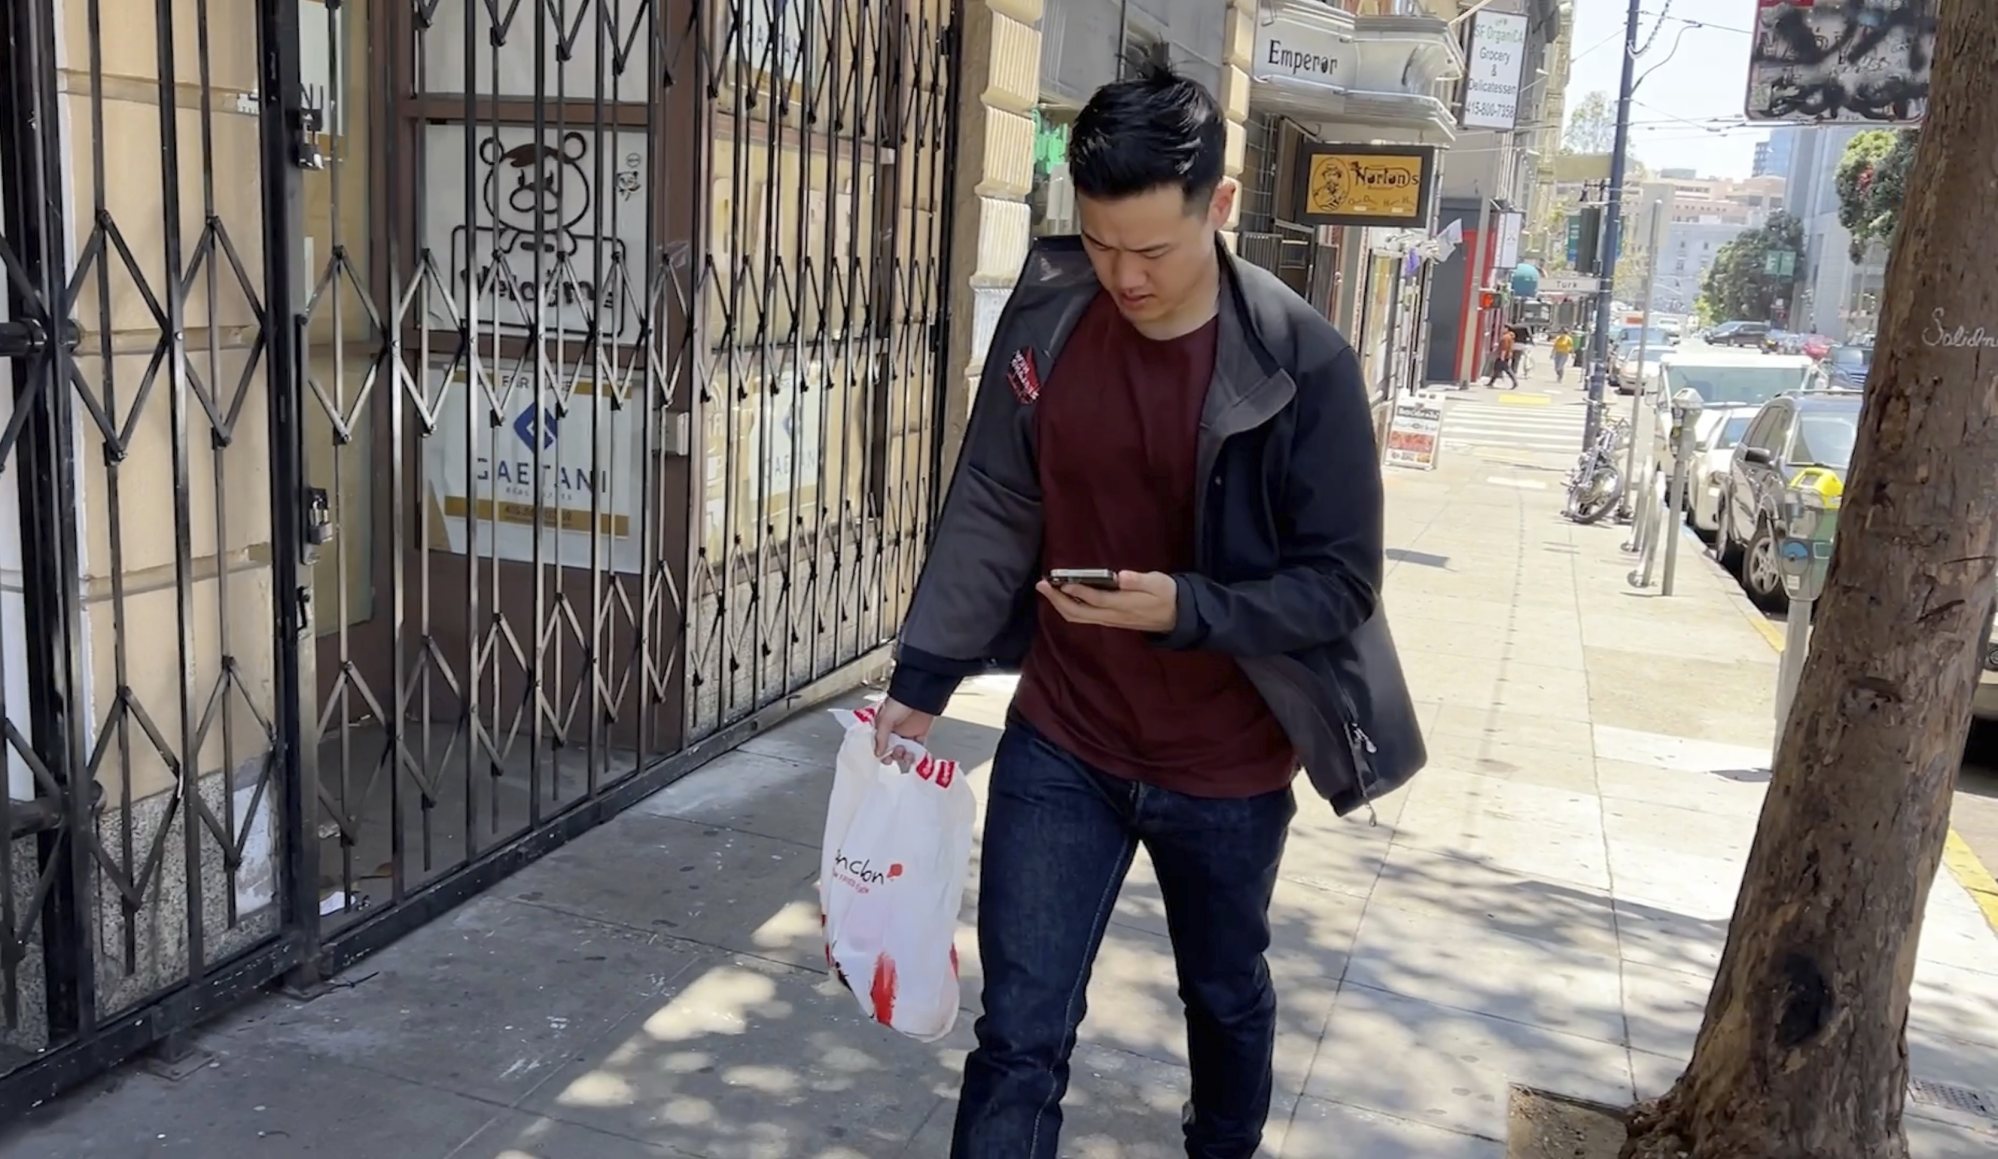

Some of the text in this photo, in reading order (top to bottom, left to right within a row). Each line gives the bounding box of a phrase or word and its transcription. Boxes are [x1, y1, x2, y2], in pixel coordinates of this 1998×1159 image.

[1268, 39, 1338, 75] Emperor
[1479, 46, 1511, 65] Grocery
[1556, 280, 1578, 289] Turk
